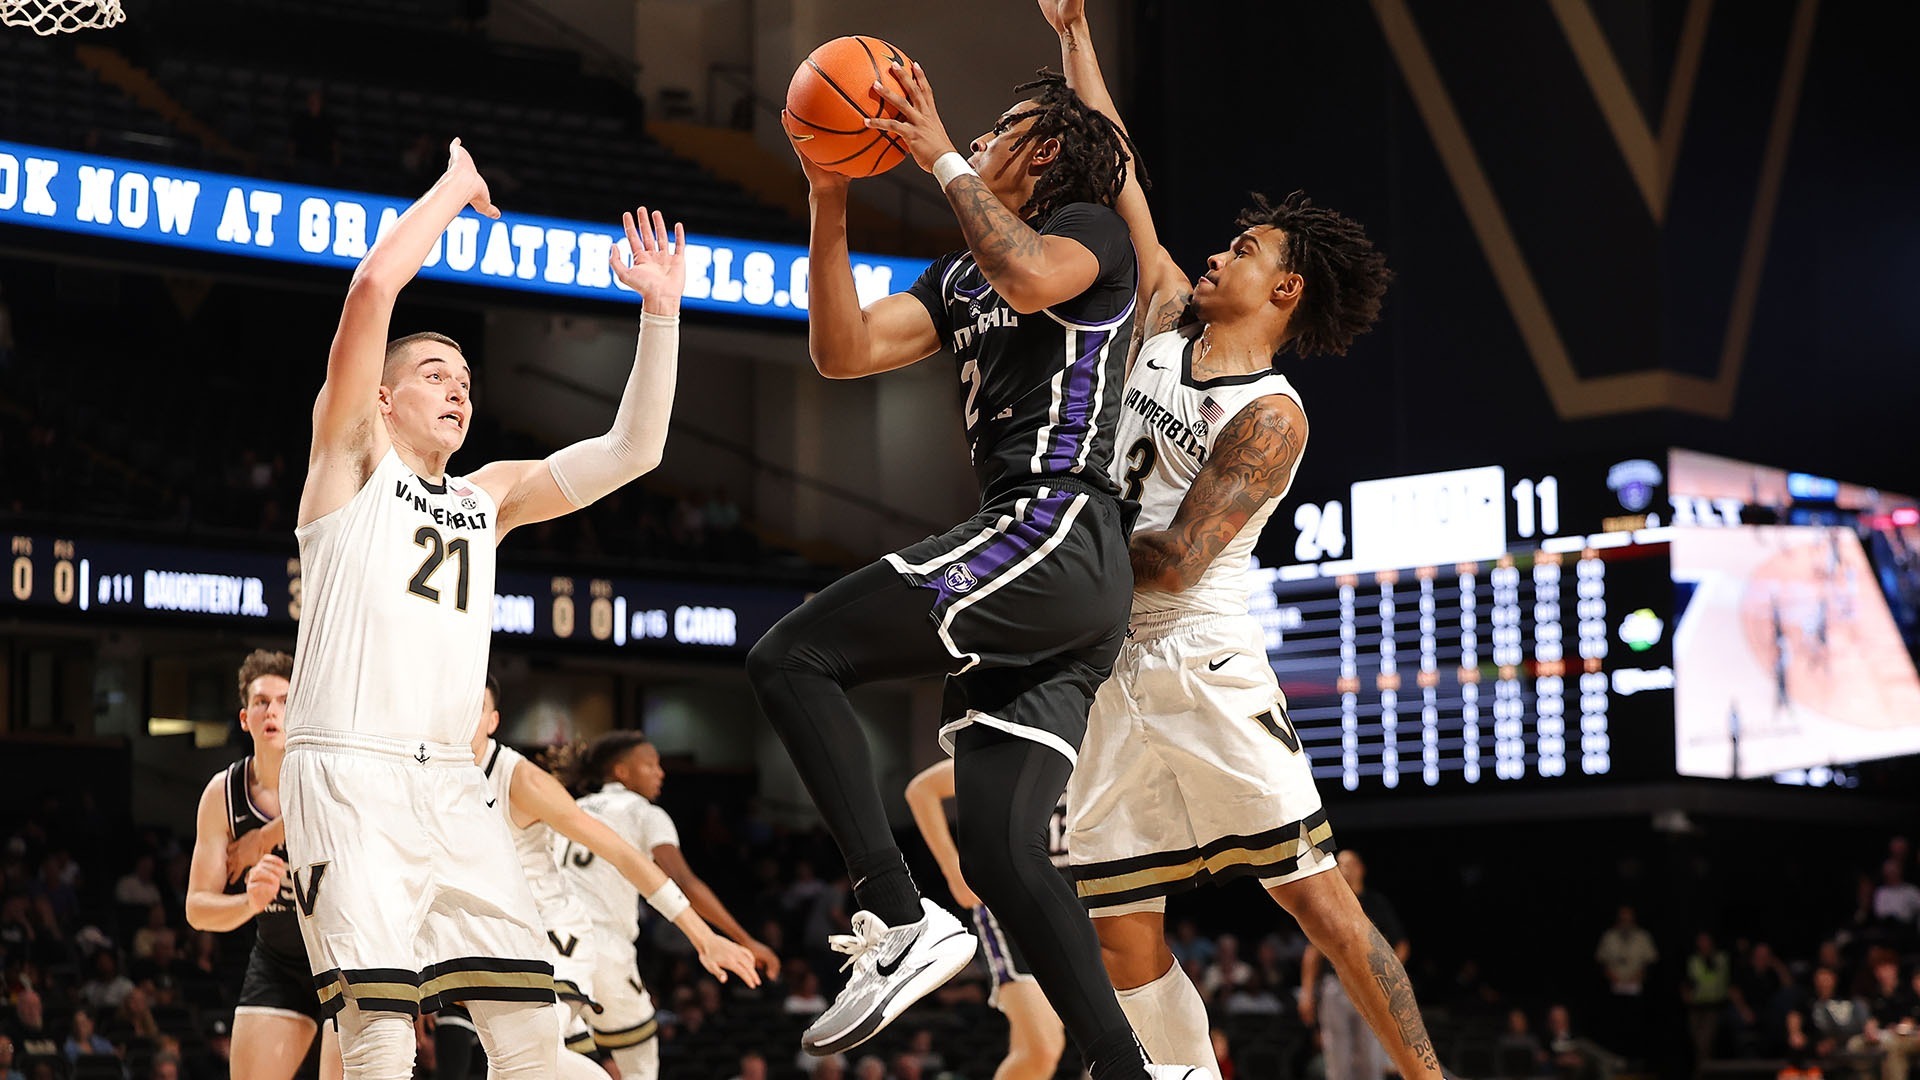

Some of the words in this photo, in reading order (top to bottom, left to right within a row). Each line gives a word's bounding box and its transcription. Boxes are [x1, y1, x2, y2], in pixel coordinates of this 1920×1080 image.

[76, 165, 200, 236] NOW
[217, 187, 282, 247] AT
[1123, 435, 1158, 502] 3
[1293, 500, 1346, 562] 24
[1511, 474, 1560, 538] 11
[12, 556, 33, 601] 0
[53, 560, 75, 604] 0
[406, 525, 470, 614] 21
[552, 594, 575, 638] 0
[590, 597, 613, 640] 0
[293, 861, 331, 919] V
